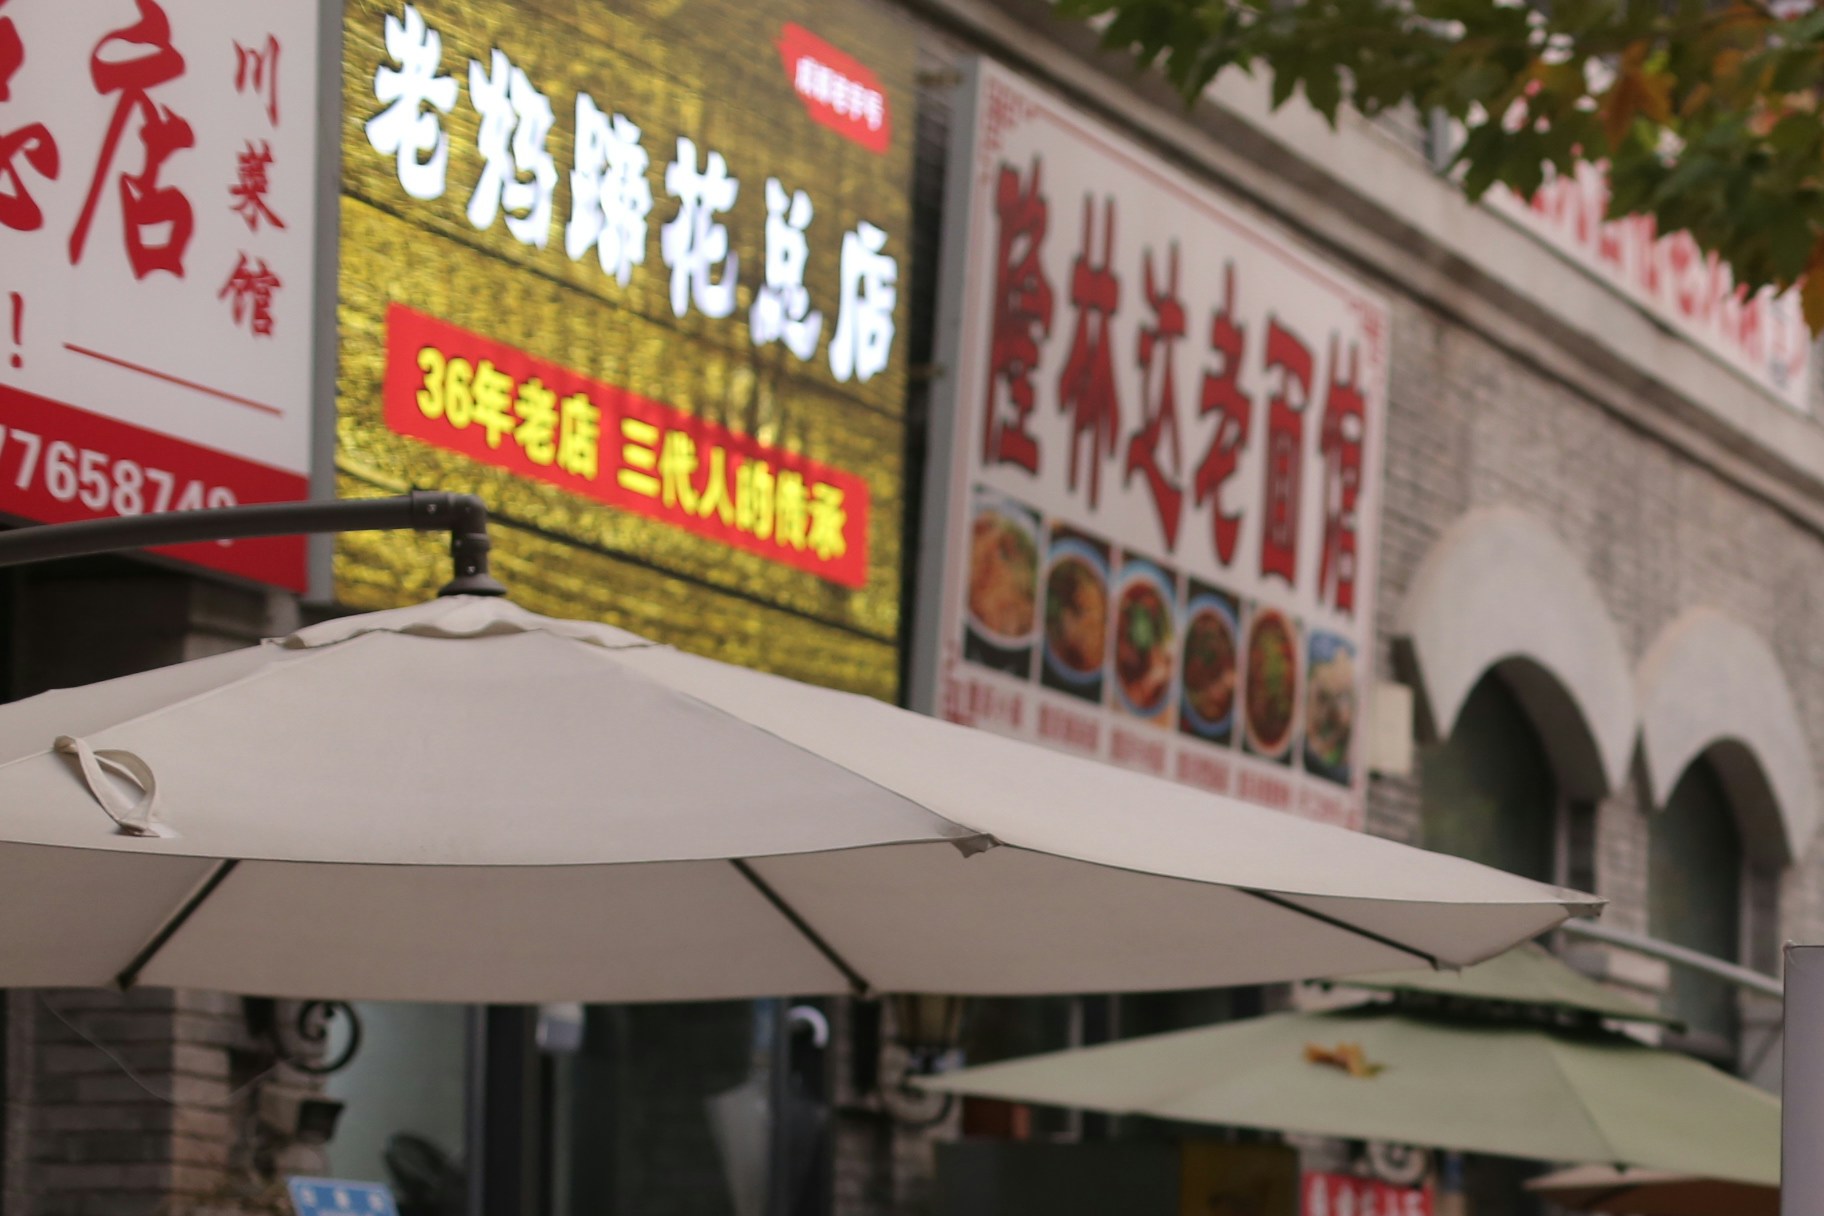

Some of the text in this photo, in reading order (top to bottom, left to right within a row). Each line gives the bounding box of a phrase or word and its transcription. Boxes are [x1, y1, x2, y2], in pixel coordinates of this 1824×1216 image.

[218, 32, 287, 338] 川菜馆
[363, 4, 897, 383] 老妈蹄花总店
[415, 346, 848, 561] 36年老店 三代人的传承
